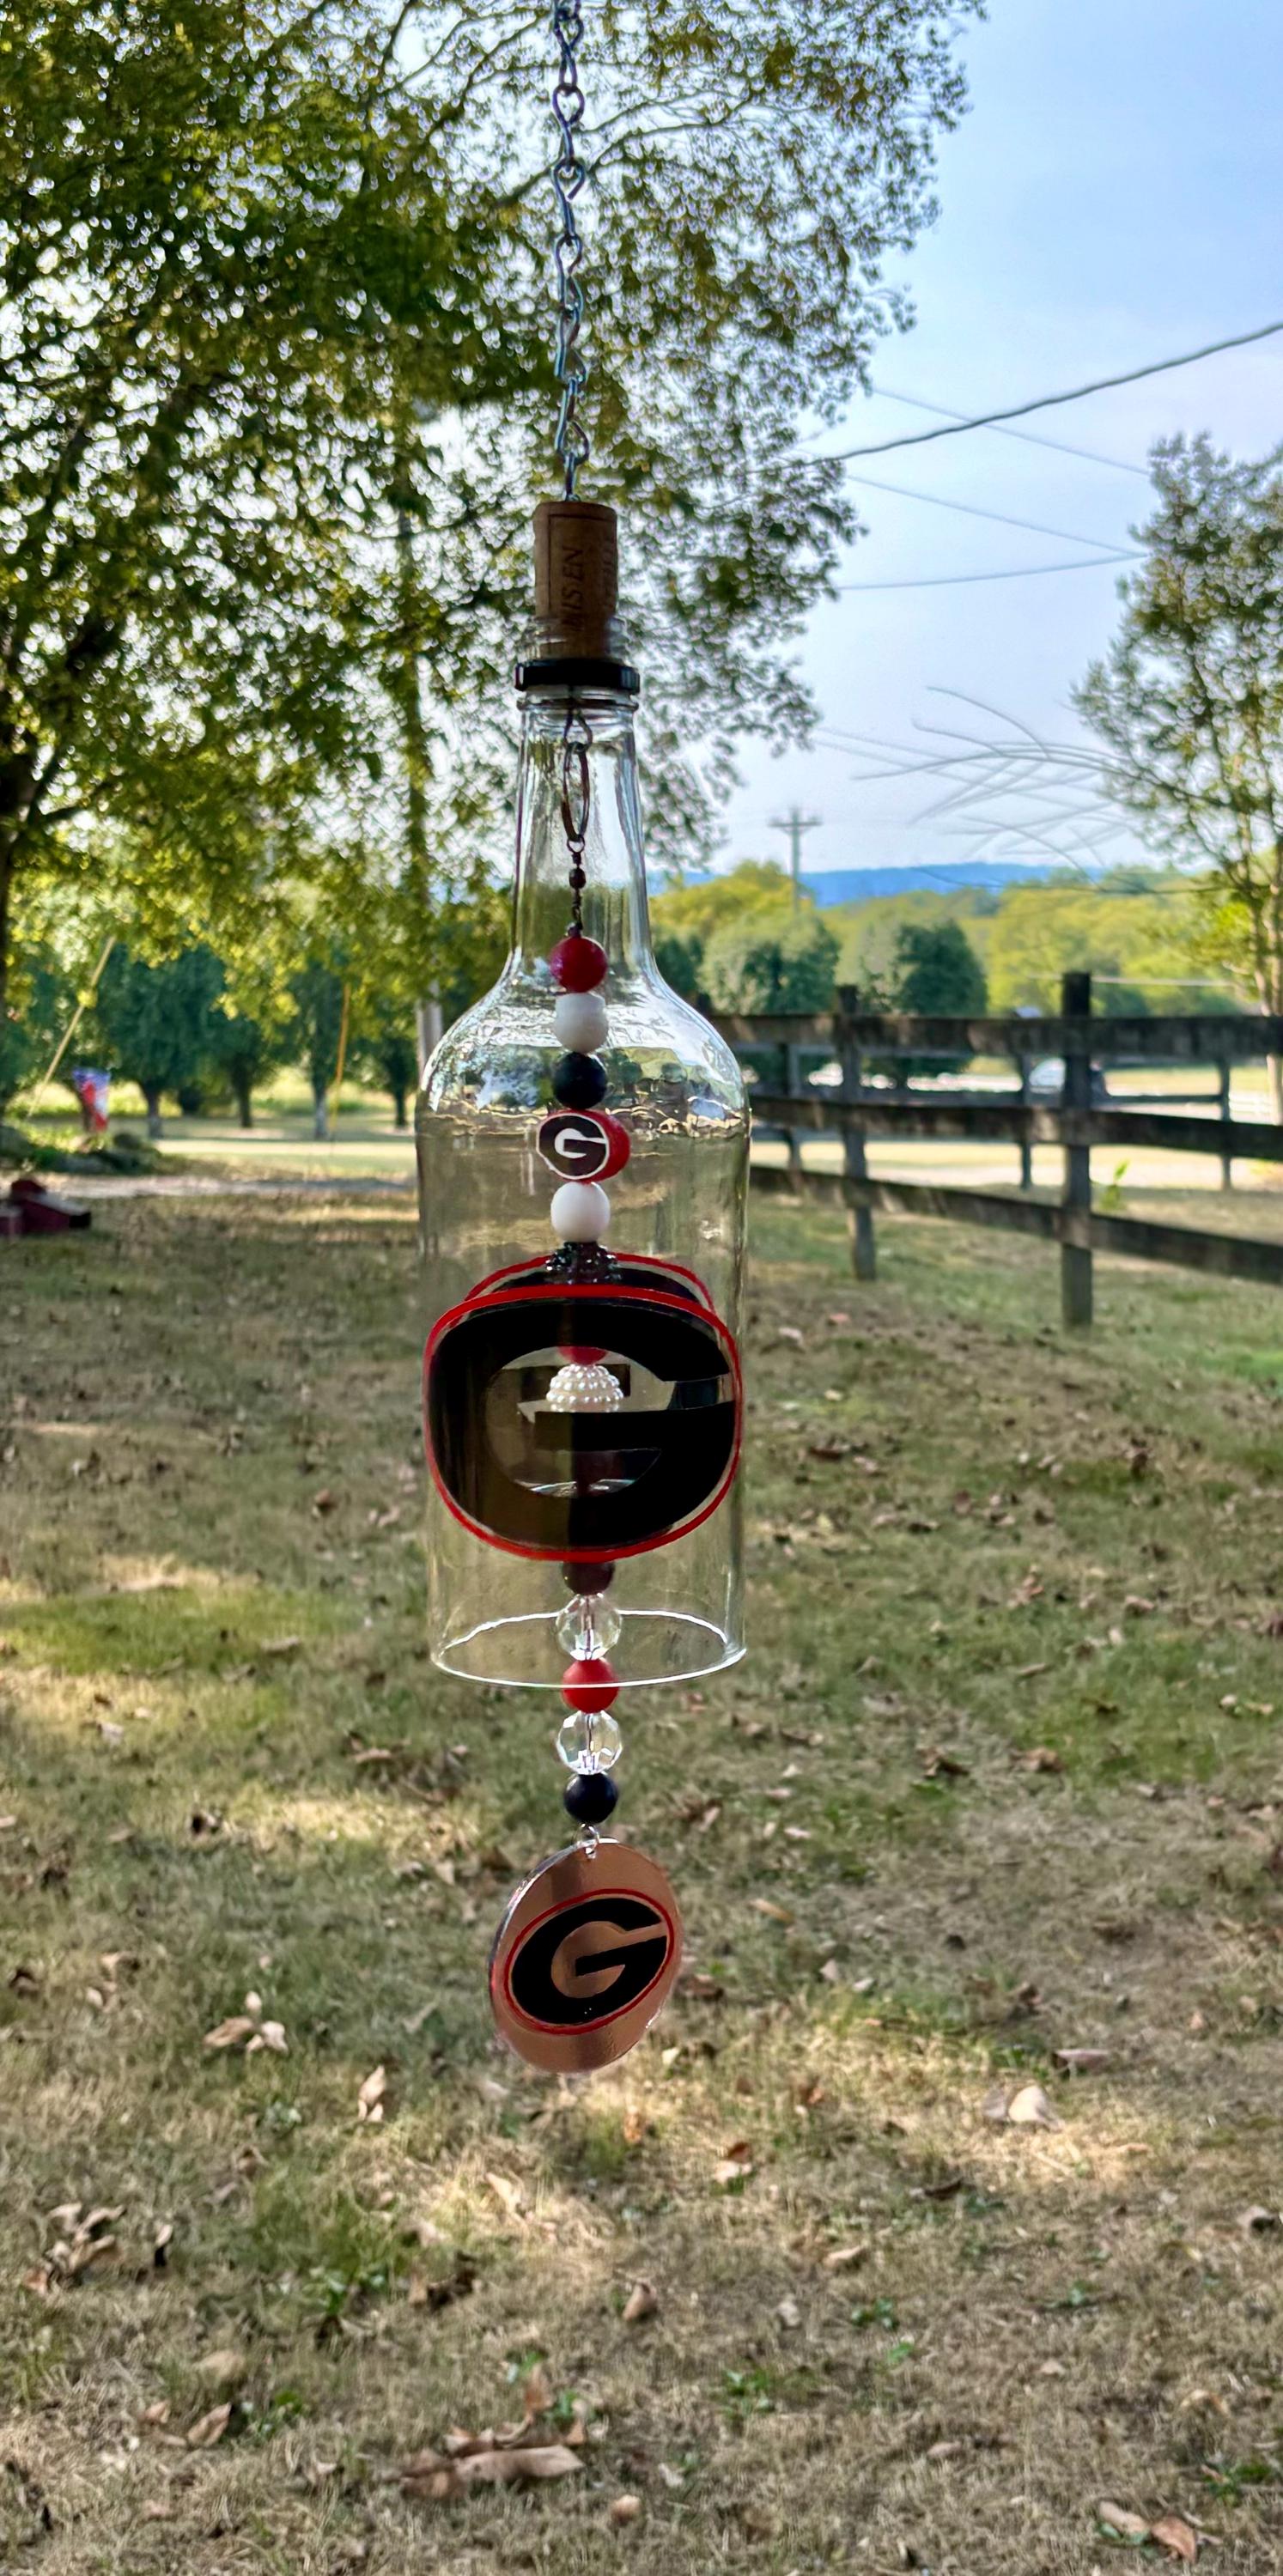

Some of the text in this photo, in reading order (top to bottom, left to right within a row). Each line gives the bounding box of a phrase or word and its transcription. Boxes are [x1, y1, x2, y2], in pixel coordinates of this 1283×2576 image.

[538, 1115, 608, 1177] G
[429, 1298, 737, 1547] G
[511, 1898, 667, 2025] G
